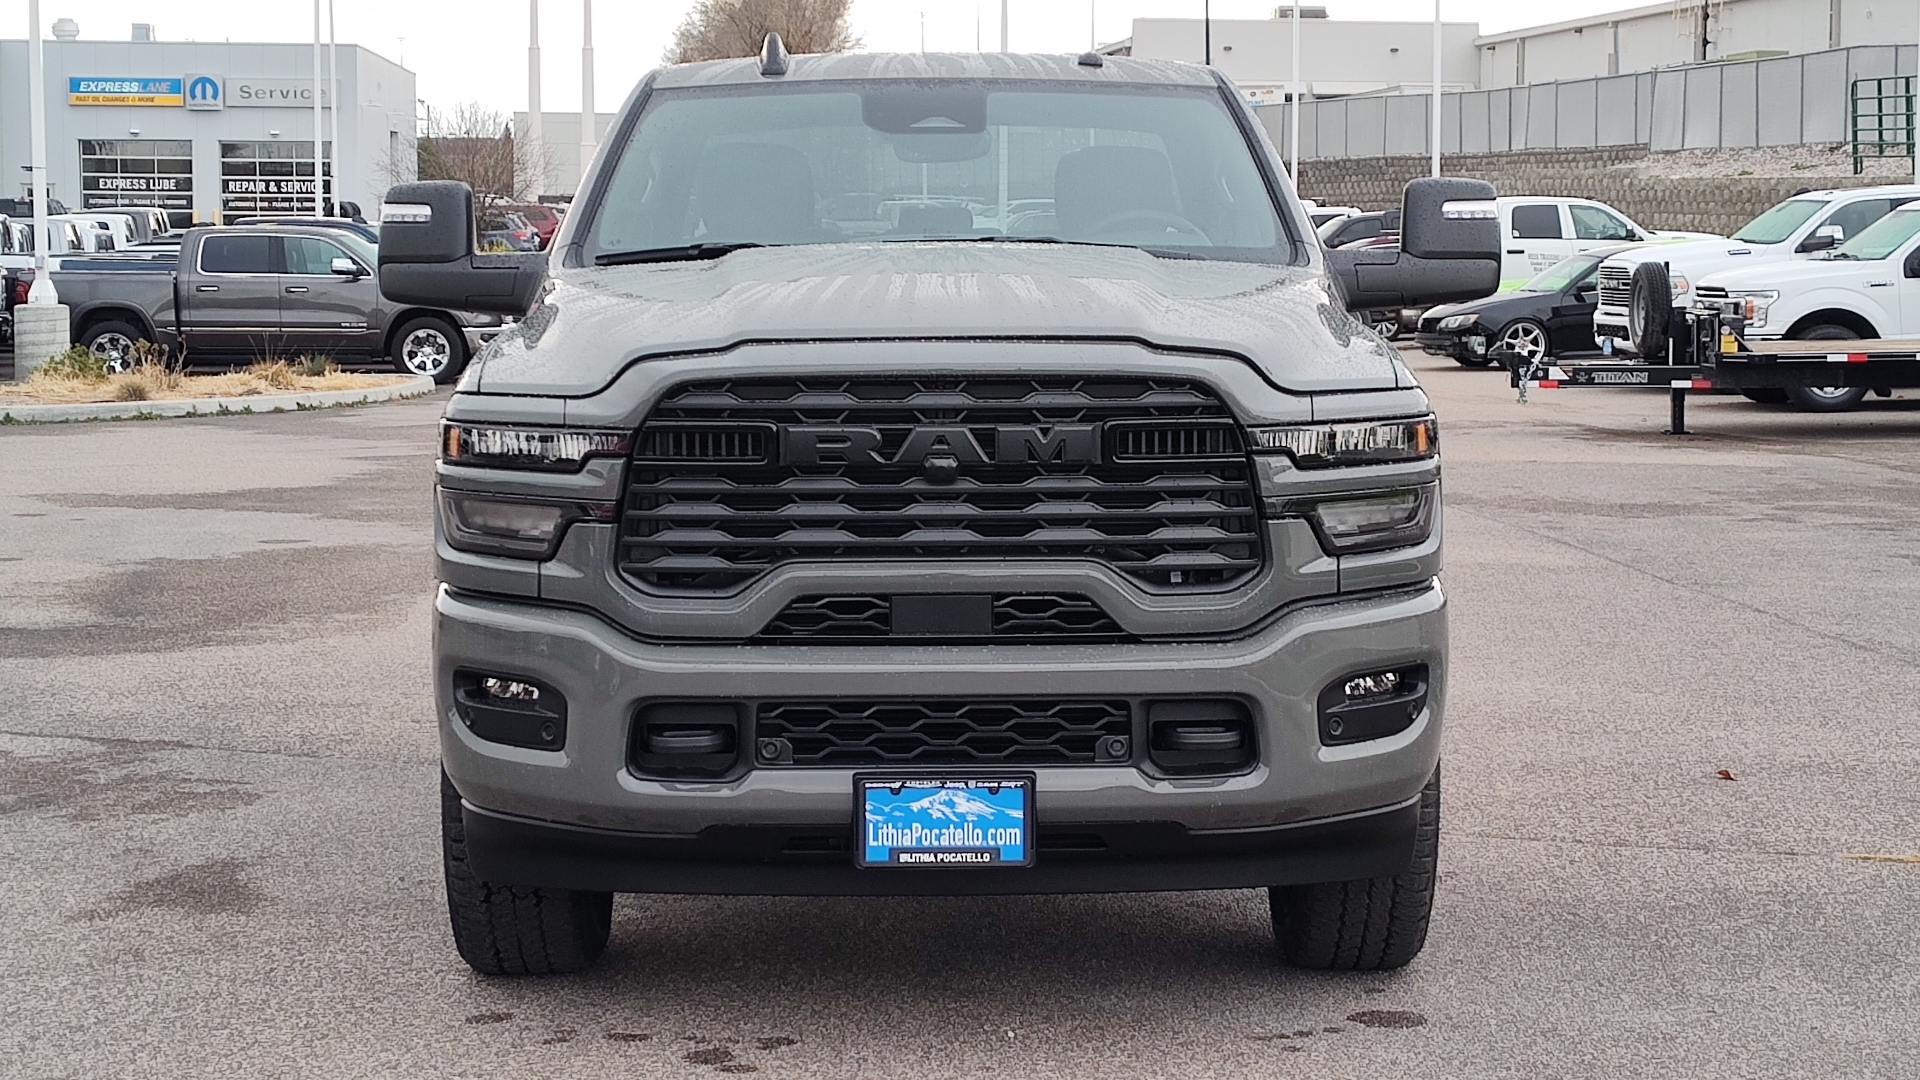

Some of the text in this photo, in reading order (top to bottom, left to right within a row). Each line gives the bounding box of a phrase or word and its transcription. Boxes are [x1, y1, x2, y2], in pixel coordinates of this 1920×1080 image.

[98, 178, 177, 190] EXPRESS LUBE
[228, 181, 324, 193] REPAIR & SERVIC
[1591, 371, 1649, 383] TITAN
[788, 423, 1095, 465] RAM
[868, 822, 1021, 846] LithiaPocatello.com
[937, 853, 991, 863] POCATELLO
